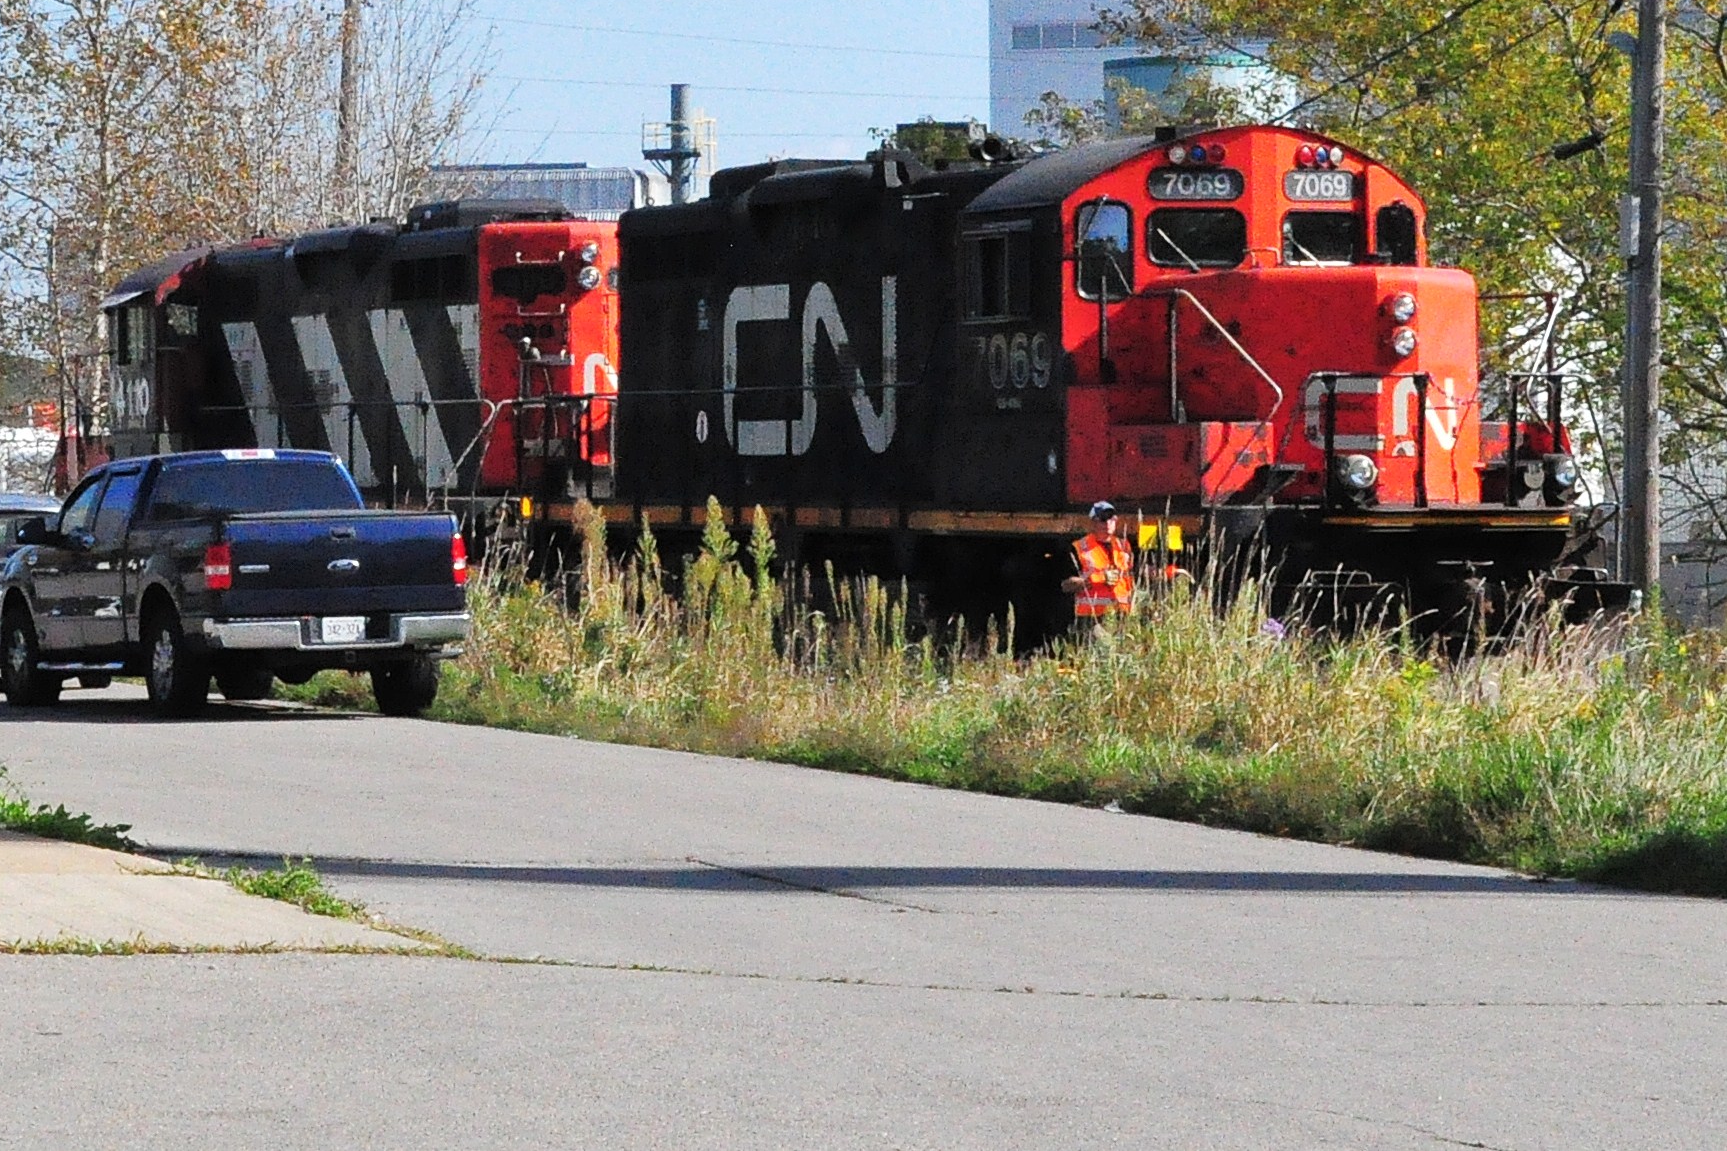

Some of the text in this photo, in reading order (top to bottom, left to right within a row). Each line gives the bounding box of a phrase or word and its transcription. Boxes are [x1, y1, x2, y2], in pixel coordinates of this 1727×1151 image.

[1163, 172, 1232, 196] 7069
[1293, 174, 1349, 197] 7069
[723, 275, 898, 457] CN
[1304, 376, 1458, 454] CN
